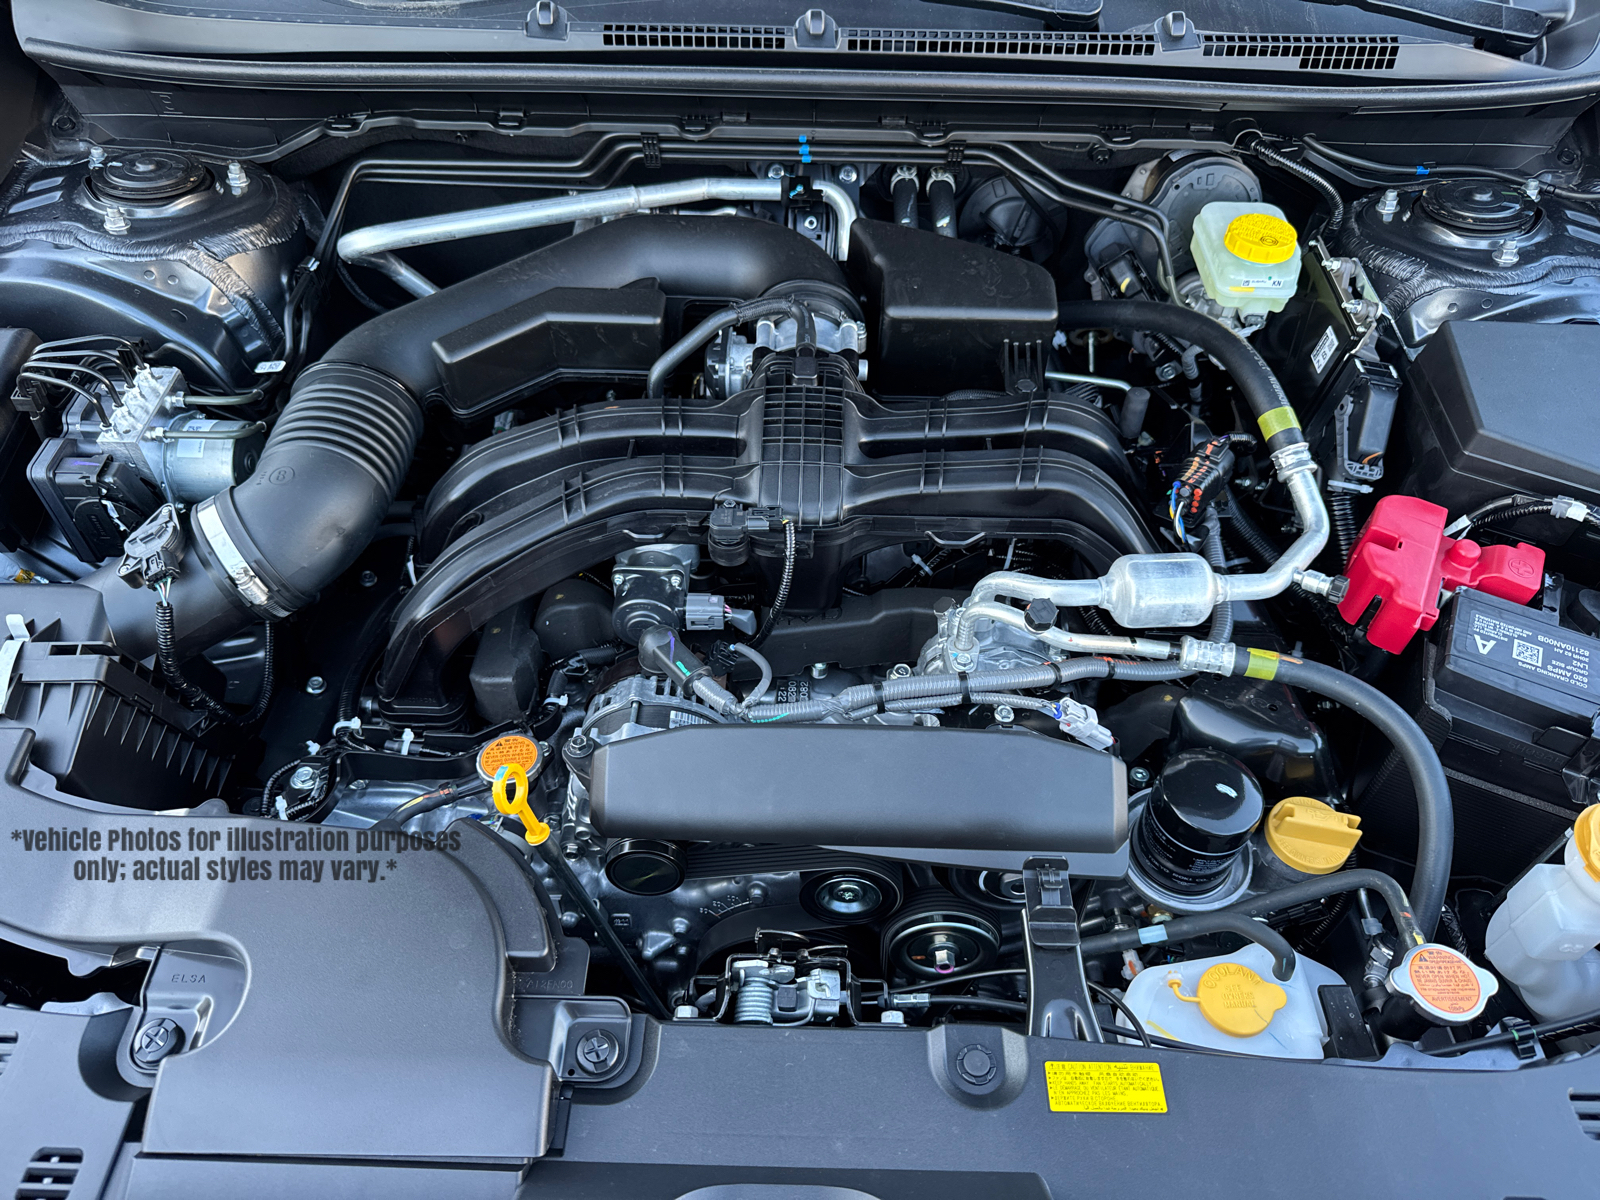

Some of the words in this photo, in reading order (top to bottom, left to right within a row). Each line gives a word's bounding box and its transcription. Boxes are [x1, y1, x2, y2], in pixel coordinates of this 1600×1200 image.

[1474, 634, 1497, 655] A
[1538, 635, 1590, 657] 82110AN00B
[1517, 661, 1536, 671] AMPS
[1551, 660, 1566, 668] SIZE
[1572, 660, 1589, 670] LN2
[1537, 667, 1570, 682] CRANKING
[1547, 665, 1572, 677] AMPS
[1566, 666, 1589, 676] GROUP
[1573, 674, 1589, 683] 620
[1570, 679, 1588, 689] COLD
[171, 973, 206, 983] ELSA
[1225, 984, 1241, 992] SEE
[1224, 1000, 1257, 1008] MANUAL
